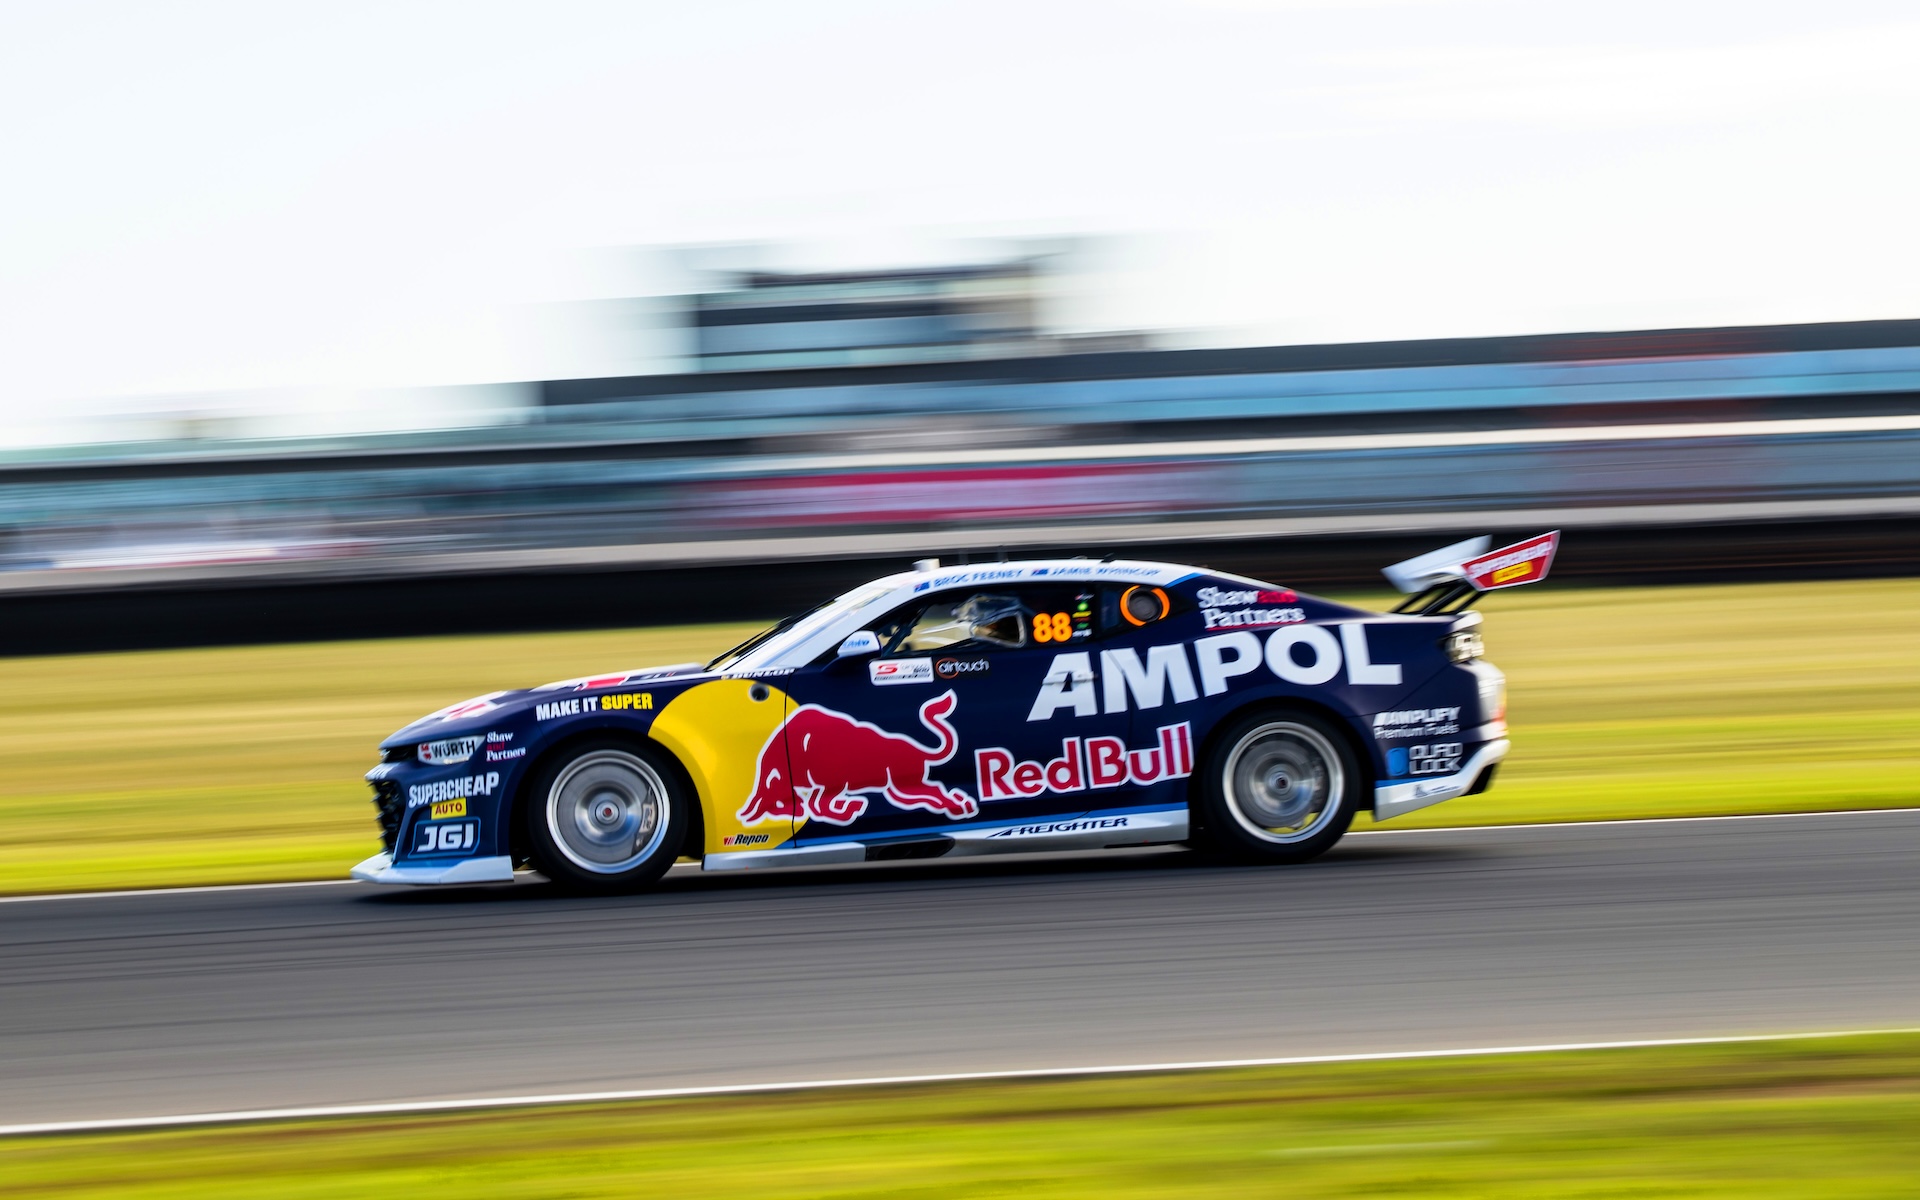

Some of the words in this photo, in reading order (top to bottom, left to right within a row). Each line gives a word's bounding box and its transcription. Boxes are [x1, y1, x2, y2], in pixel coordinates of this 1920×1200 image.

[973, 568, 1024, 580] FEENEY
[1196, 586, 1258, 608] Shaw
[1032, 611, 1073, 643] 88
[1200, 607, 1307, 629] Partners
[731, 668, 796, 679] DUNLOP
[939, 658, 990, 674] airtouch
[1027, 624, 1402, 722] AMPOL
[535, 699, 580, 721] MAKE
[582, 696, 598, 713] IT
[601, 692, 653, 710] SUPER
[1384, 706, 1461, 727] AMPLIFY
[487, 731, 513, 743] Shaw
[1374, 725, 1423, 740] Premium
[431, 739, 476, 759] WÜRTH
[486, 741, 505, 751] and
[486, 747, 526, 761] Partners
[1409, 742, 1463, 760] QUAD
[974, 736, 1086, 801] Red
[1085, 720, 1195, 790] Bull
[1409, 757, 1461, 775] LOCK
[408, 771, 500, 808] SUPERCHEAP
[435, 802, 463, 815] AUTO
[1004, 817, 1128, 837] FREIGHTER
[417, 823, 474, 852] JGI
[734, 834, 769, 846] Repco
